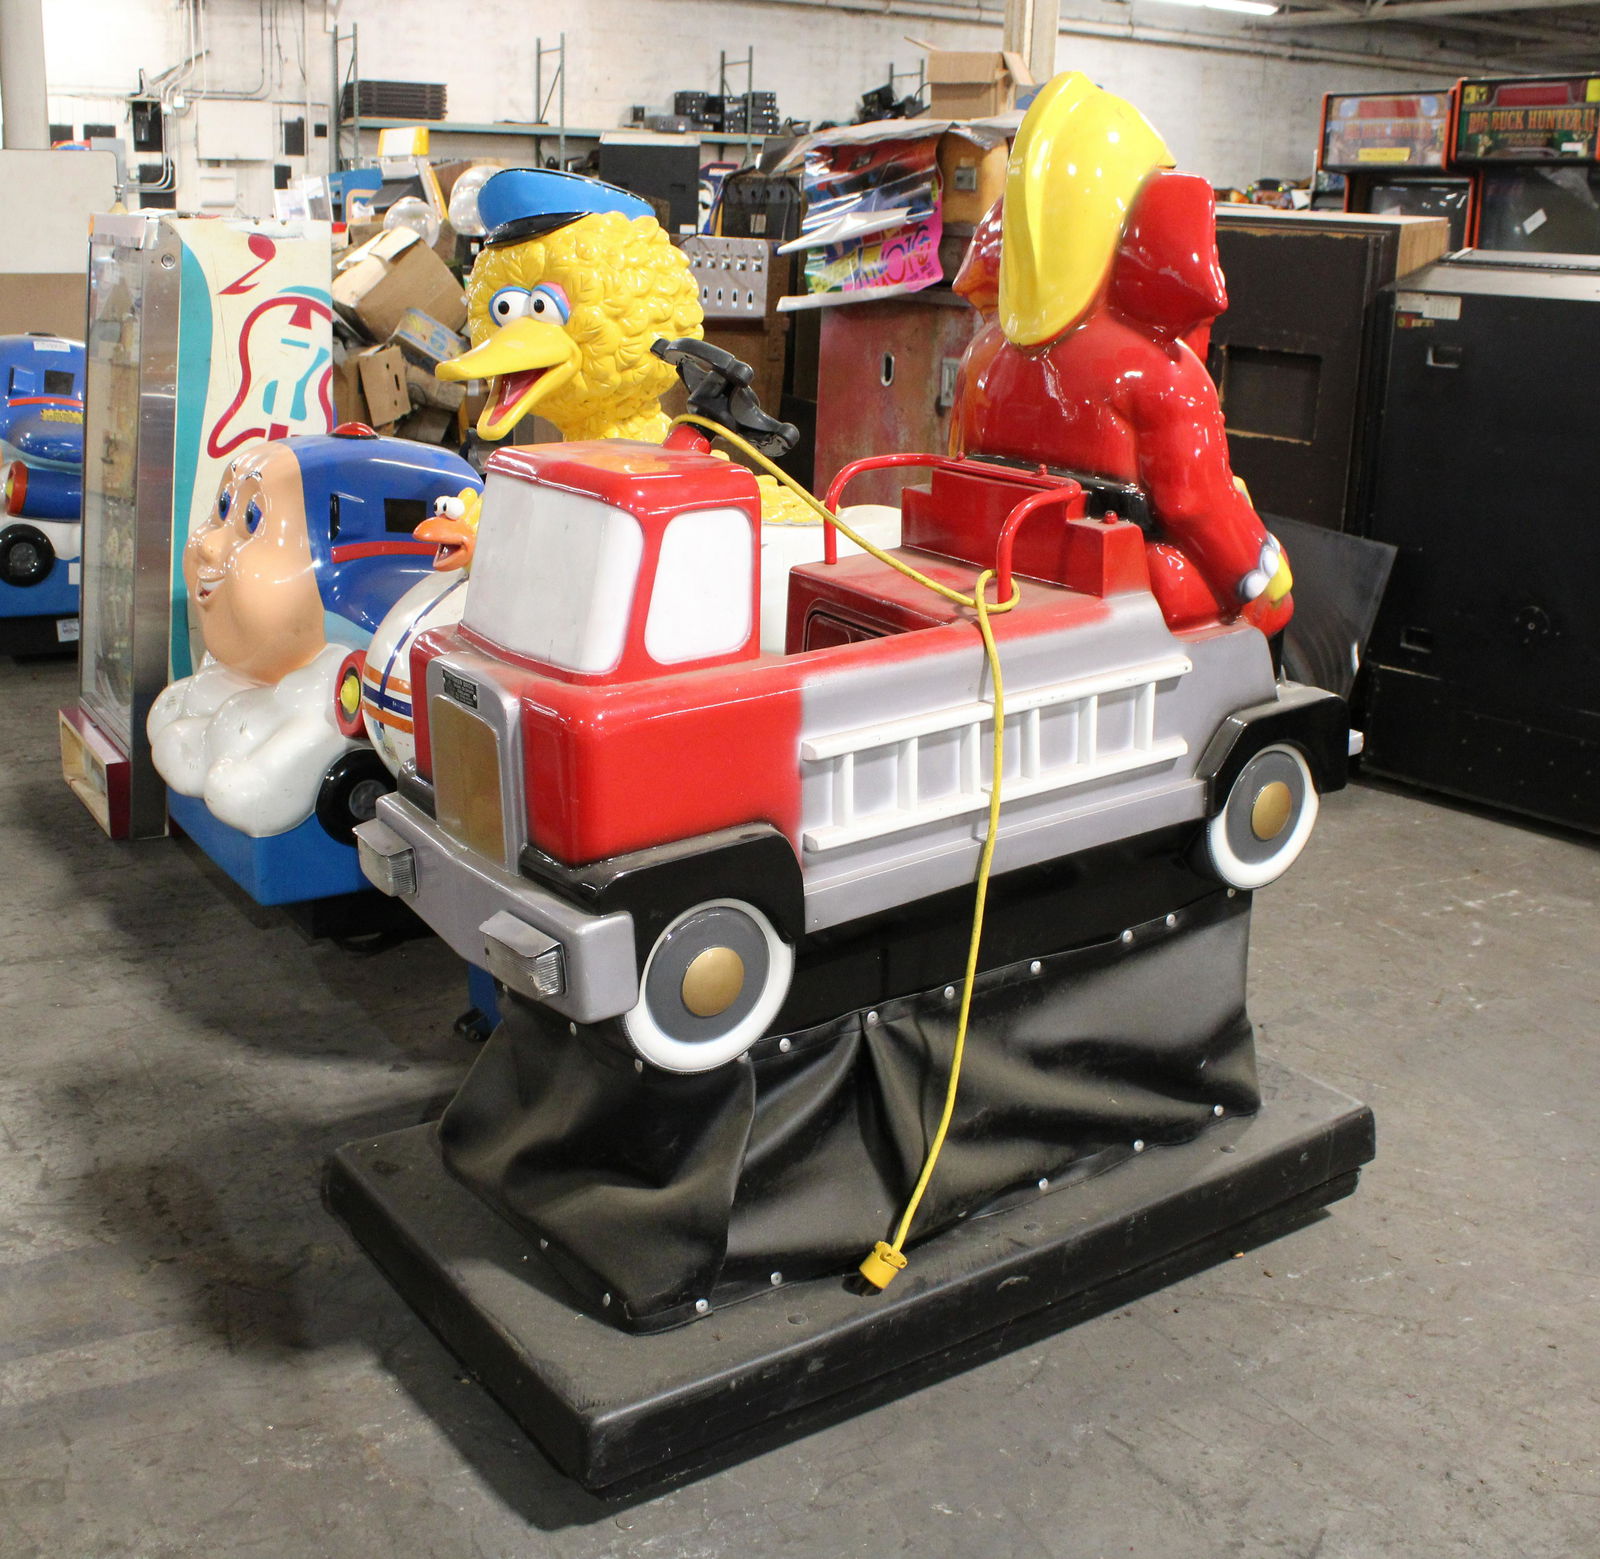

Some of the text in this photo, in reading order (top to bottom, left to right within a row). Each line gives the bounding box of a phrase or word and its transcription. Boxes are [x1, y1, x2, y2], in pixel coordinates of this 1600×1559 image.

[1468, 112, 1489, 134] BIG
[1491, 110, 1524, 131] BUCK
[1528, 109, 1581, 131] HUNTER
